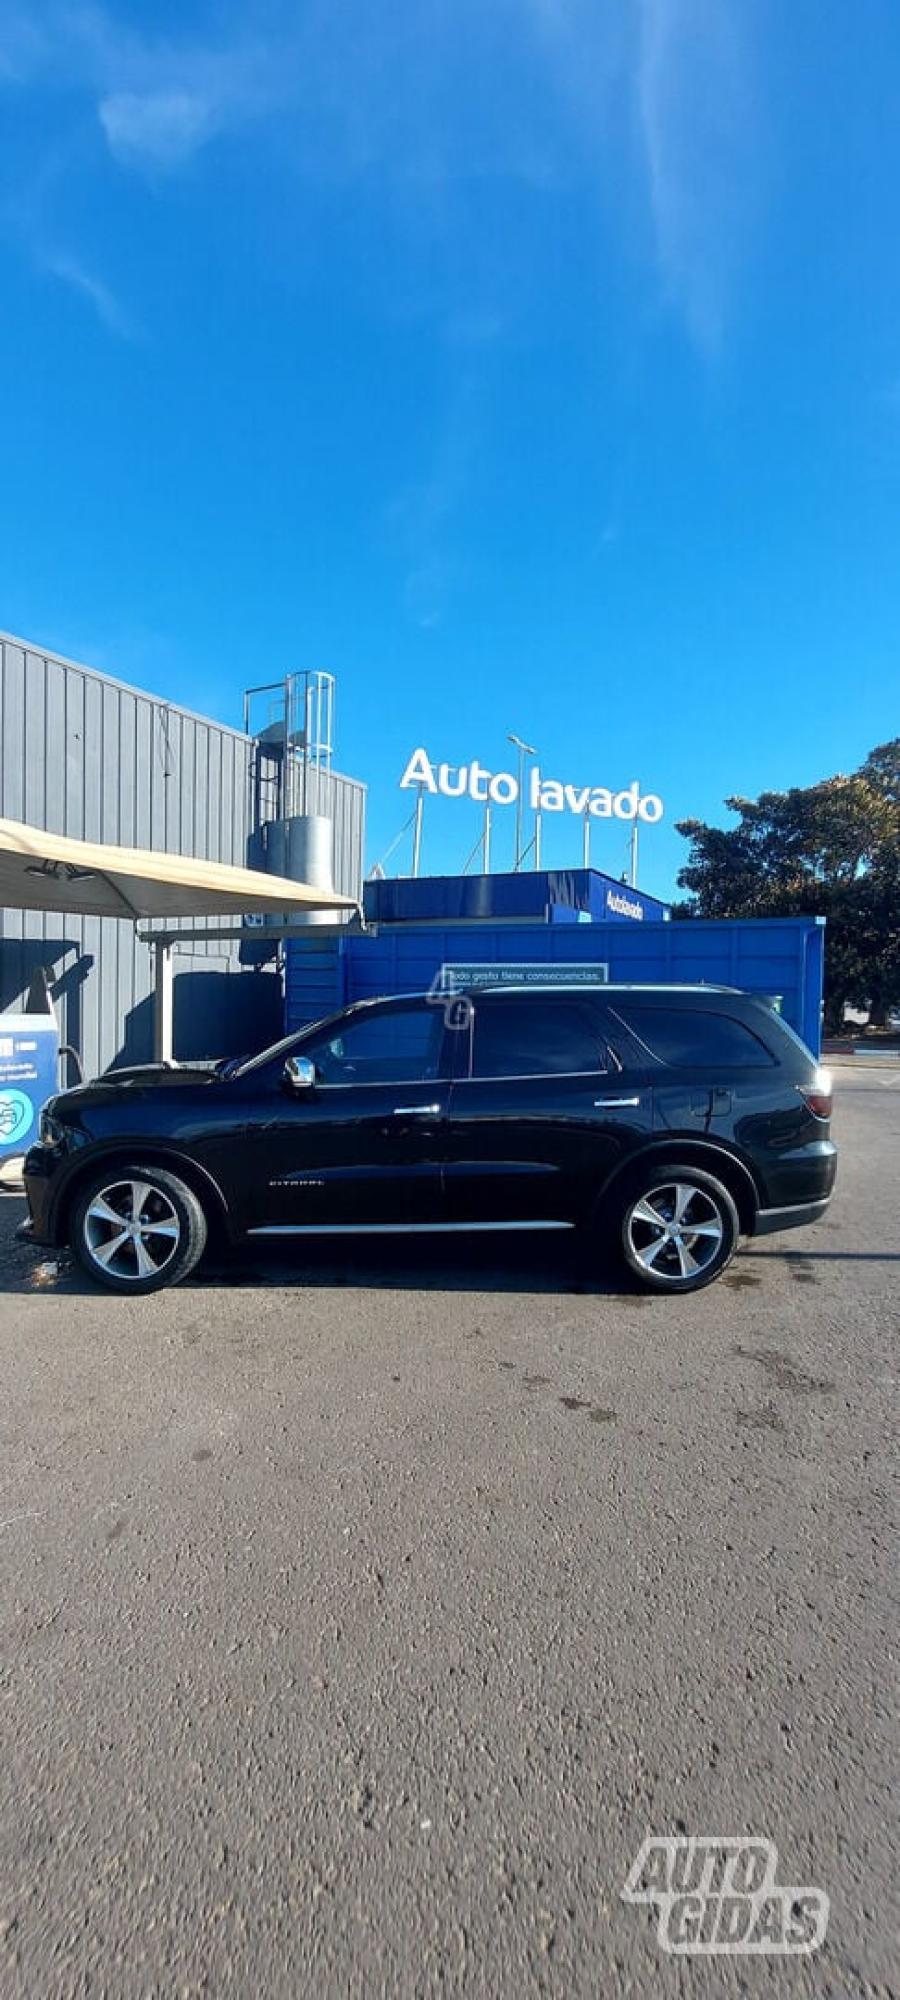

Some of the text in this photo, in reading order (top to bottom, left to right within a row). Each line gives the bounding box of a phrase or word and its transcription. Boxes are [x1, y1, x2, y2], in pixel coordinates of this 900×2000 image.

[400, 747, 664, 823] Auto lavado
[472, 971, 499, 983] gesto
[502, 971, 524, 981] tiene
